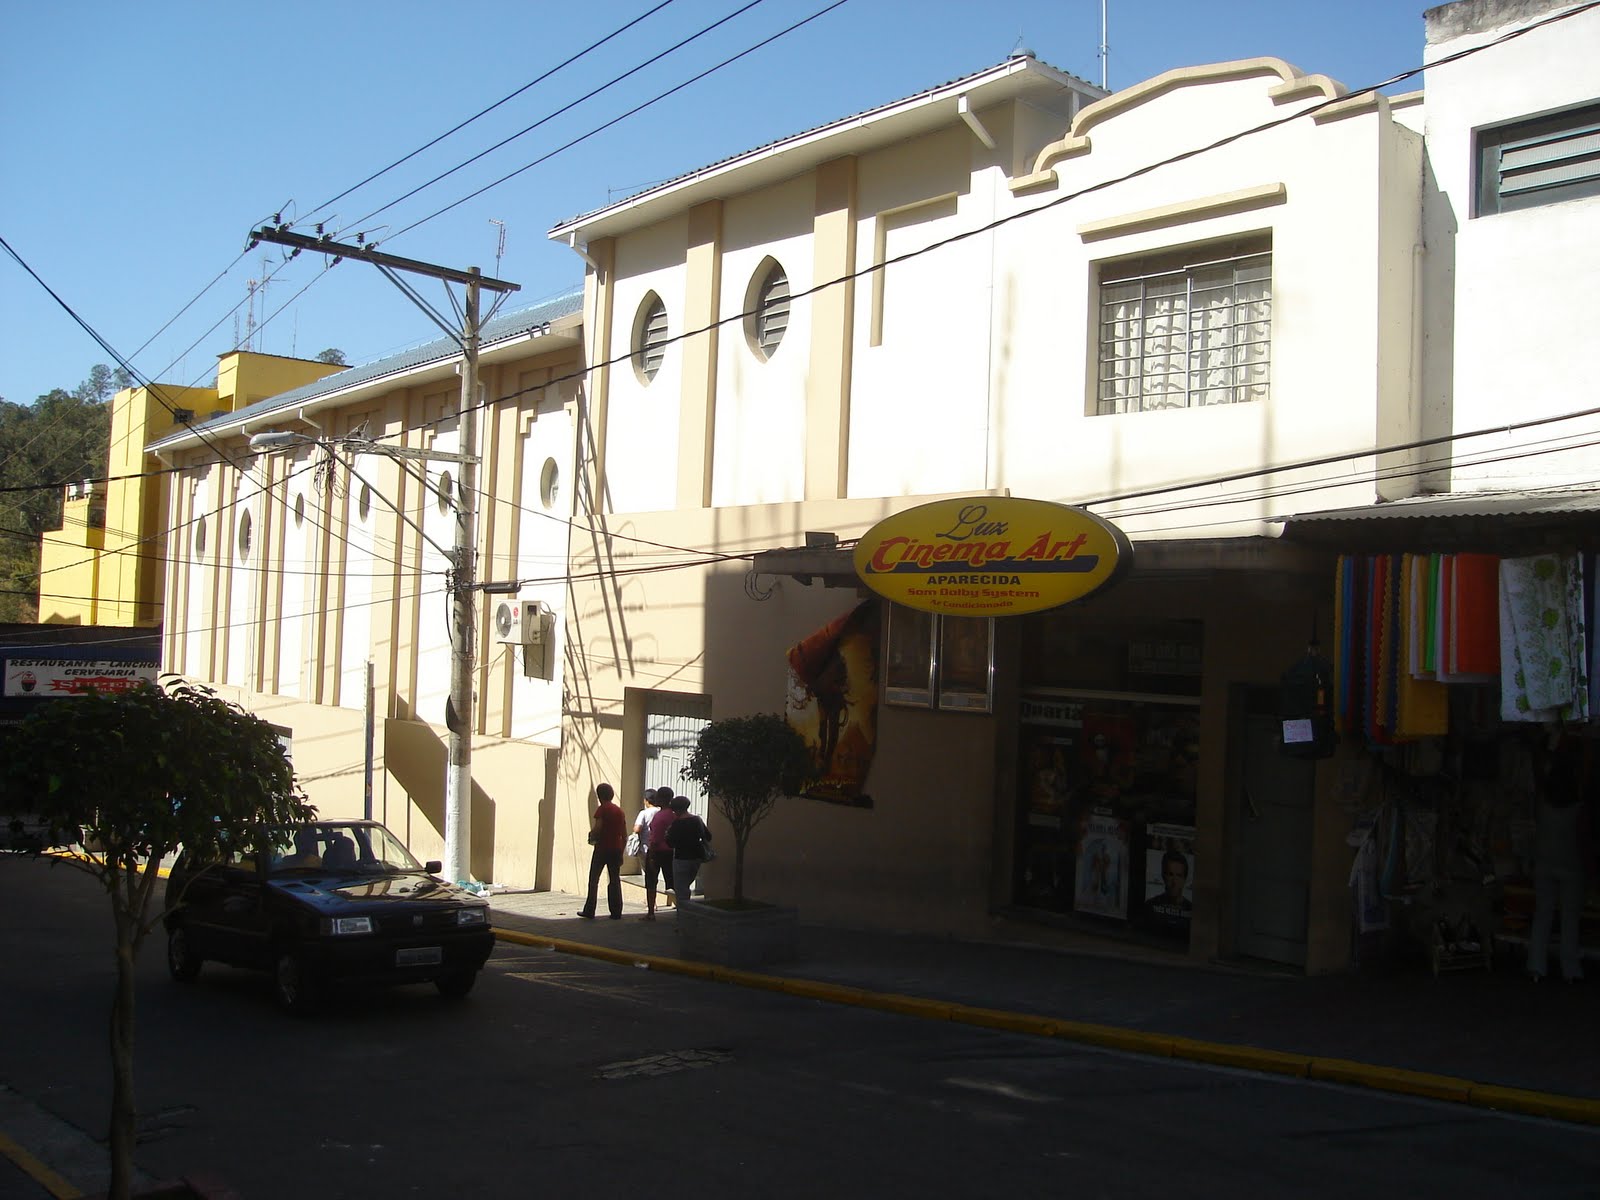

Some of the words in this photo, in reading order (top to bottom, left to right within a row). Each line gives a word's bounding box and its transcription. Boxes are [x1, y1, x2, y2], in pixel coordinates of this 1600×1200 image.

[935, 505, 1008, 541] Lux
[872, 537, 1011, 570] Cinema
[1018, 531, 1088, 560] Art
[927, 575, 1021, 585] APARECIDA
[908, 588, 937, 597] Som
[940, 588, 979, 599] Dolby
[981, 589, 1039, 599] System
[10, 660, 96, 668] RESTAURANTE
